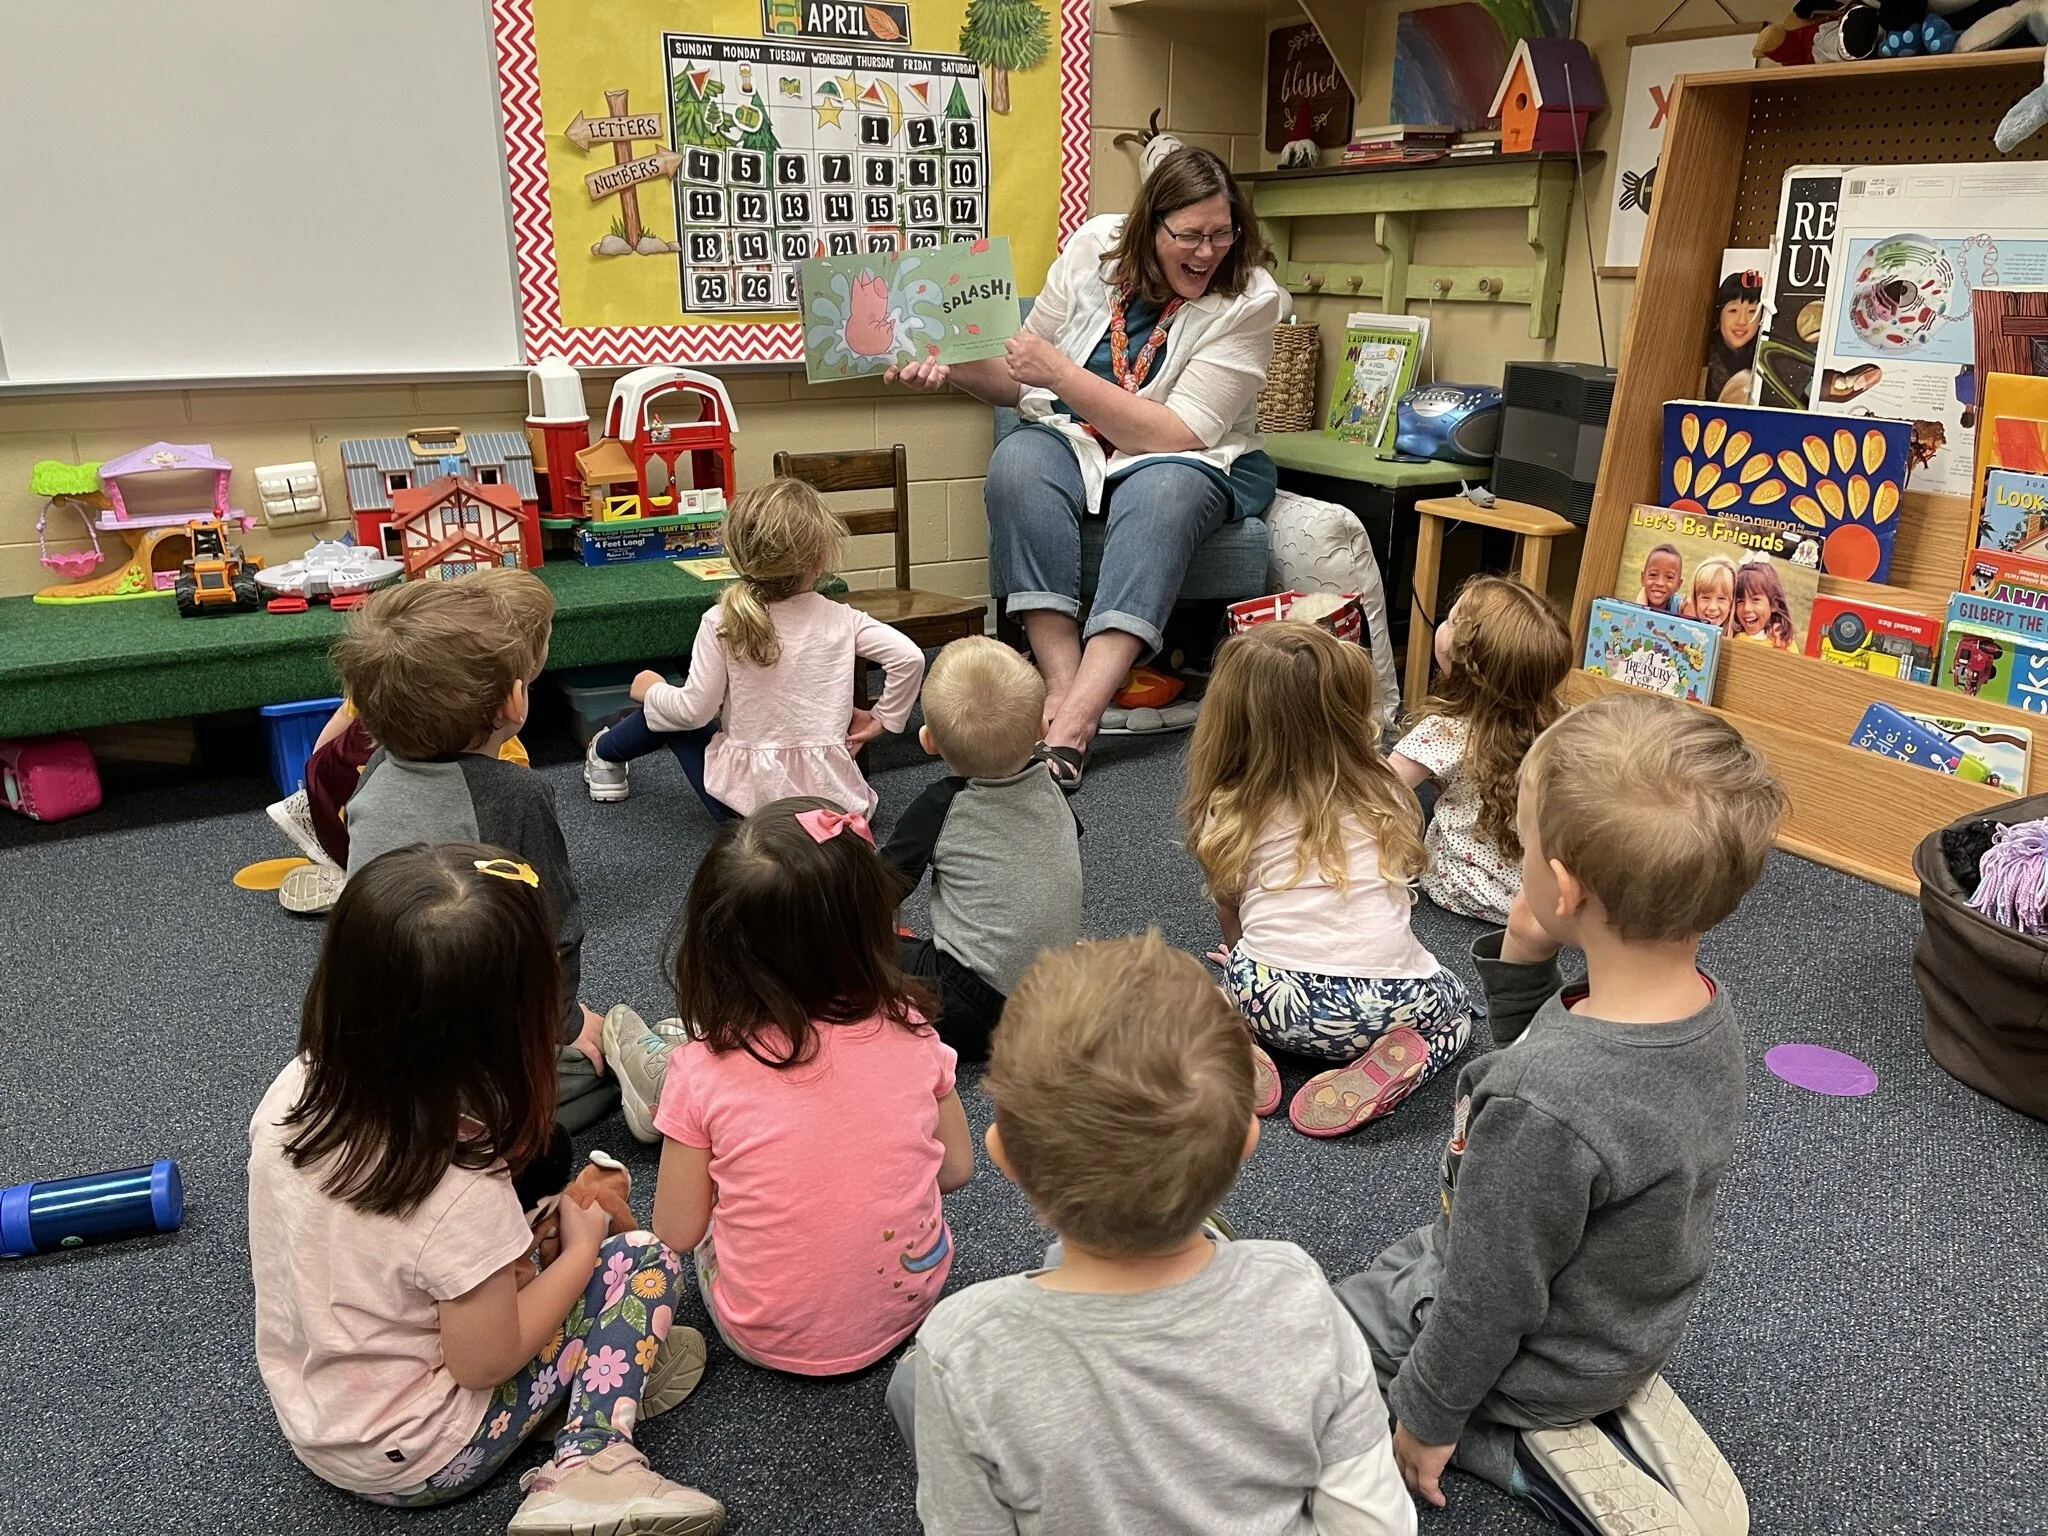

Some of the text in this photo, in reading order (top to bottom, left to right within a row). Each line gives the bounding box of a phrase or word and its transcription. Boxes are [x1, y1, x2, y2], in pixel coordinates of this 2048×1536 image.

[807, 3, 868, 36] APRIL
[675, 42, 976, 75] SUNDAY MONDAY TUESDAY WEDNESDAY THURSDAY FRIDAY SATURDAY
[1282, 61, 1340, 102] blessed
[588, 118, 656, 138] LETTERS
[872, 121, 968, 145] 1 2 3
[1509, 129, 1521, 145] 7
[594, 158, 660, 194] NUMBERS
[700, 153, 971, 184] 4 5 6 7 8 9 10
[696, 195, 972, 220] 11 12 13 14 15 16 17
[1790, 202, 1837, 240] RE
[697, 235, 933, 259] 18 19 20 21 22 23
[702, 279, 721, 299] 25
[746, 278, 766, 297] 26
[942, 279, 1012, 314] SPLASH!
[1348, 335, 1412, 346] LAURIE BERKNER
[1633, 509, 1676, 532] Let's
[1682, 517, 1706, 537] Be
[1712, 522, 1784, 552] Friends
[1718, 512, 1796, 532] Donald Crews
[602, 540, 621, 548] Feet
[623, 538, 646, 546] Long!
[1960, 602, 2044, 632] GILBERT THE
[1624, 658, 1676, 685] TREASURY
[1641, 652, 1654, 666] A
